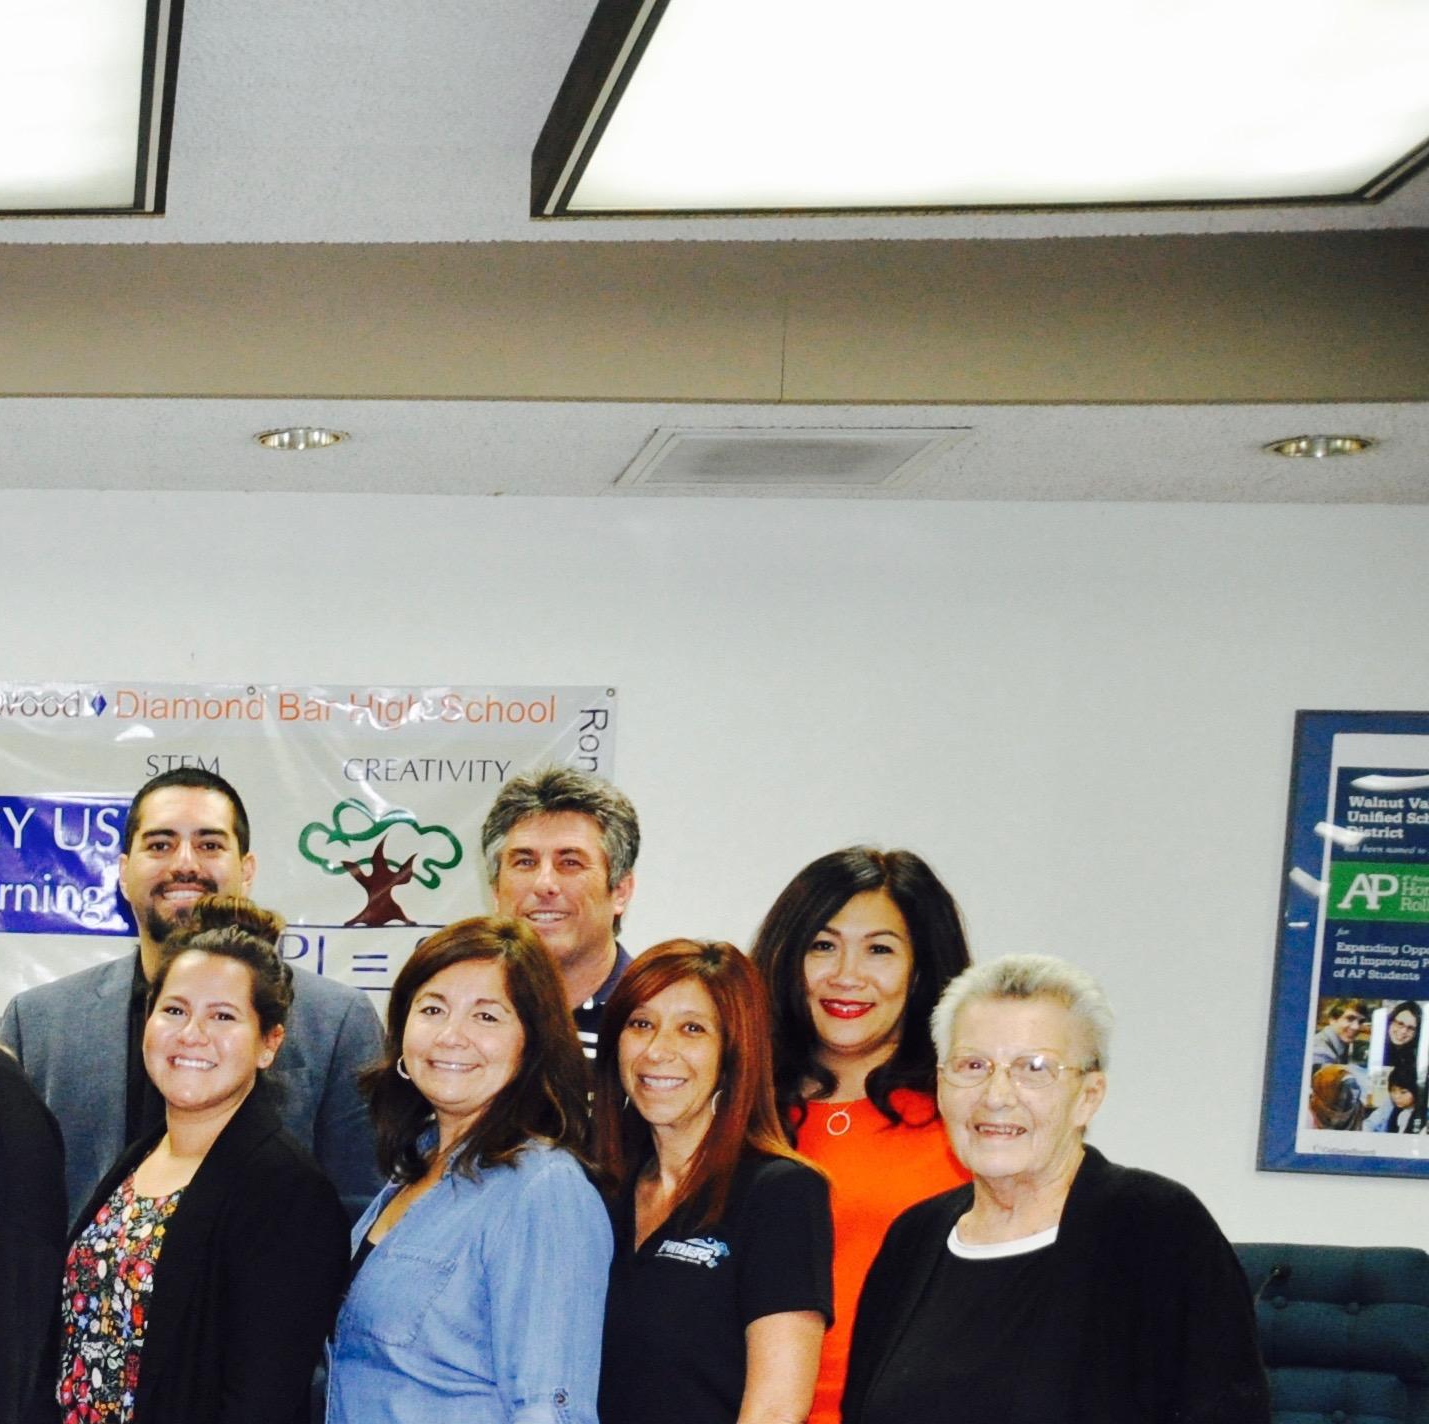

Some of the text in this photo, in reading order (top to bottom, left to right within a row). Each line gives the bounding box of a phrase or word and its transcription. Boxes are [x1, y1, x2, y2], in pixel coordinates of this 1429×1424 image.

[115, 690, 265, 722] Diamond
[278, 693, 334, 723] Bar
[441, 694, 556, 724] School
[145, 754, 220, 777] STEM
[343, 758, 512, 783] CREATIVITY
[1348, 796, 1429, 809] Walnut Va
[1346, 811, 1403, 823] Unified
[53, 806, 126, 851] US
[1336, 873, 1399, 910] AP
[1336, 942, 1398, 956] Expanding
[1334, 956, 1358, 965] and
[1359, 956, 1420, 969] Improving
[1333, 968, 1420, 981] of AP Students
